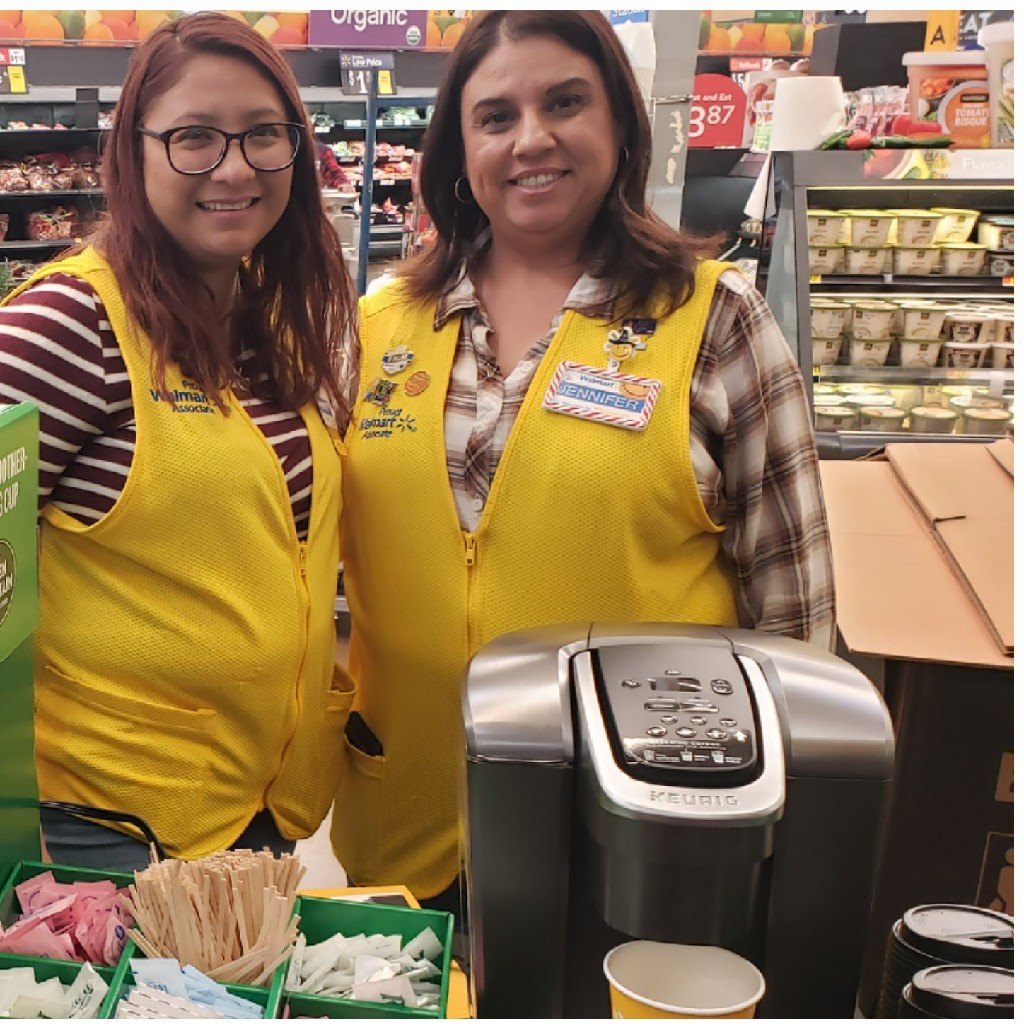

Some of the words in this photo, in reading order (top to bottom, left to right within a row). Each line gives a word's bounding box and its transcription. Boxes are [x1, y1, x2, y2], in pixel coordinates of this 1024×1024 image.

[330, 10, 408, 31] Organic
[702, 93, 718, 101] and
[719, 93, 732, 101] Eat
[954, 117, 988, 127] BISQUE
[580, 374, 614, 388] Walmart
[561, 383, 640, 410] JENNIFER
[3, 481, 20, 515] CUP
[650, 790, 739, 807] KEURIG
